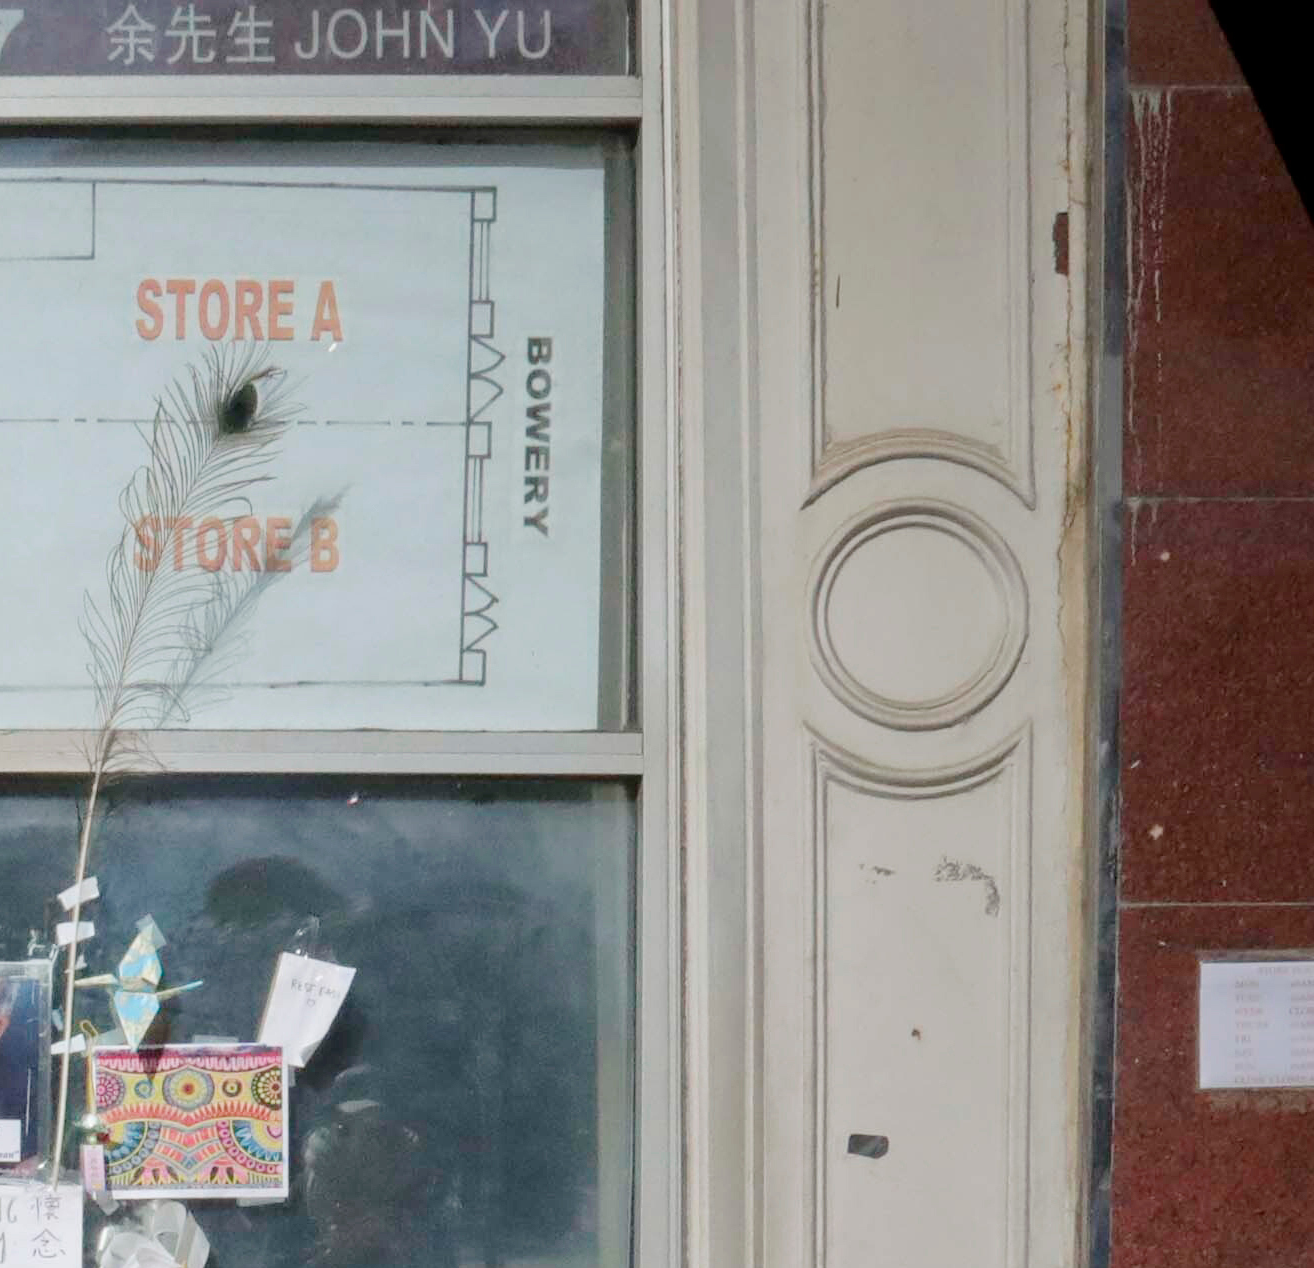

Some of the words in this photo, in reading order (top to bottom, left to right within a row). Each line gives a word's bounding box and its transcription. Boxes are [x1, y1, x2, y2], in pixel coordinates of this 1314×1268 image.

[106, 4, 276, 65] 余先生
[294, 9, 455, 60] JOHN
[474, 8, 552, 60] YU
[135, 279, 295, 342] STORE
[310, 280, 344, 342] A
[523, 336, 554, 538] BOWERY
[133, 514, 293, 574] STORE
[309, 518, 340, 574] B
